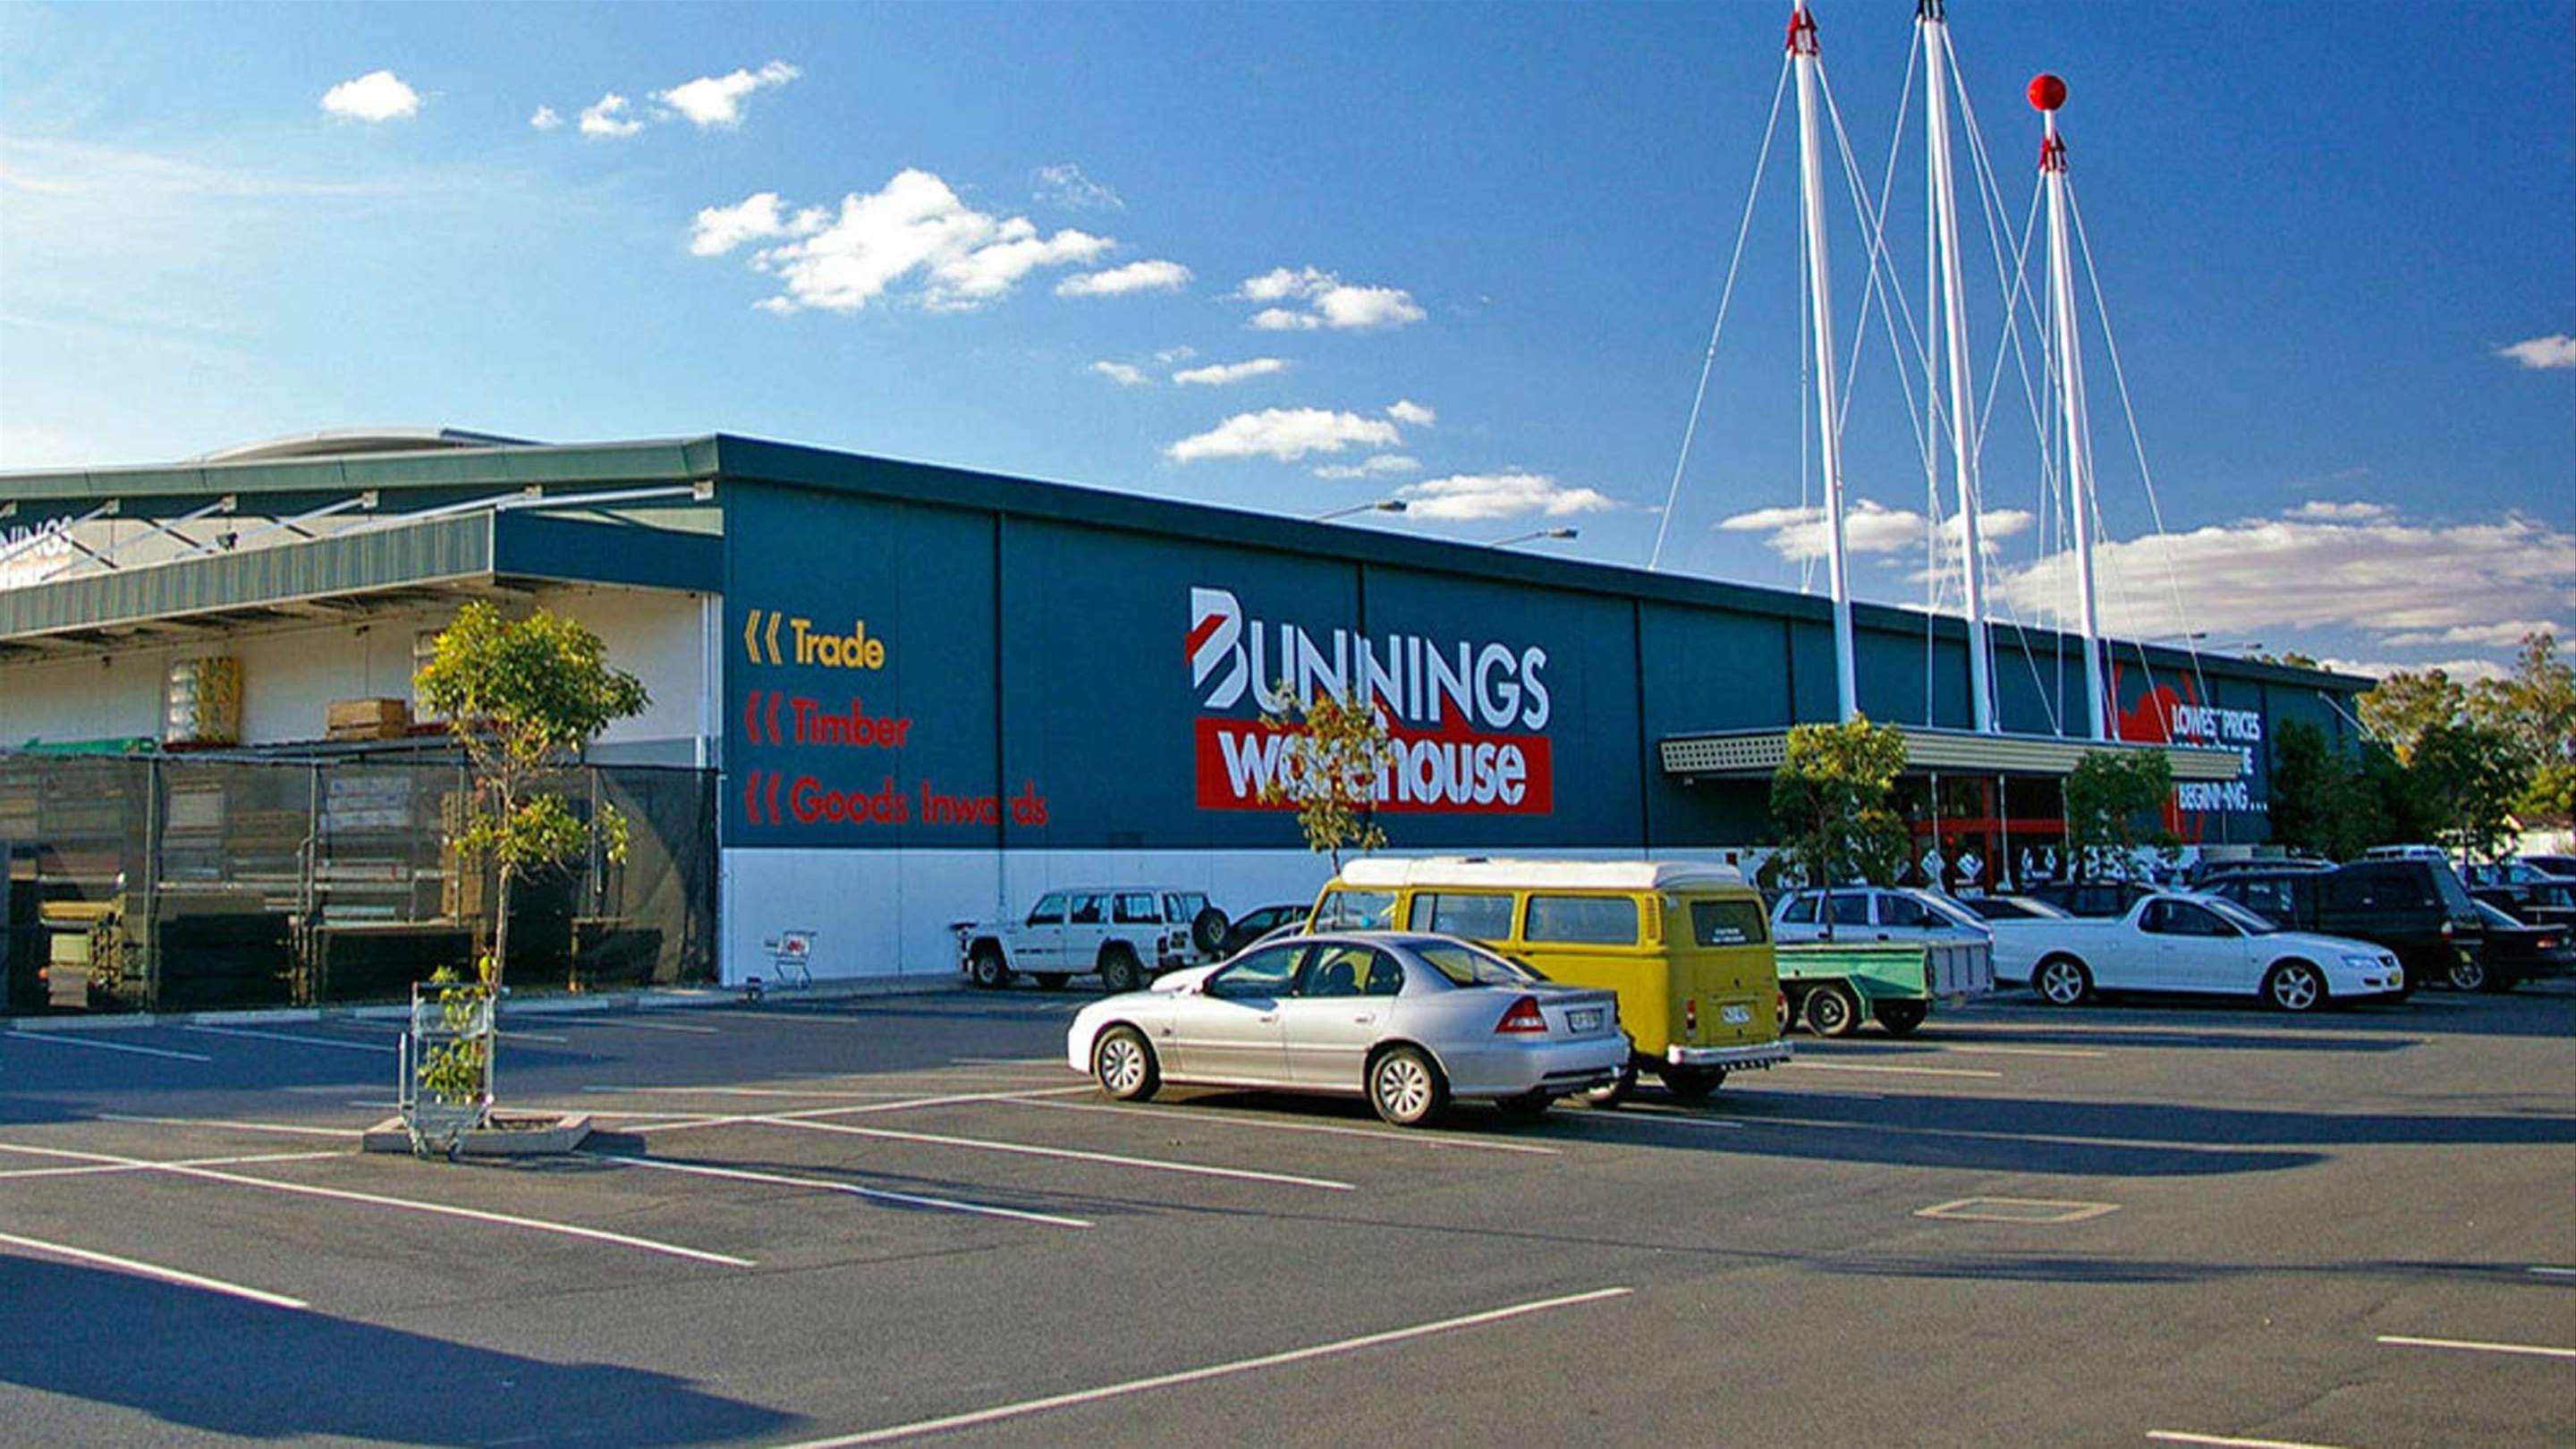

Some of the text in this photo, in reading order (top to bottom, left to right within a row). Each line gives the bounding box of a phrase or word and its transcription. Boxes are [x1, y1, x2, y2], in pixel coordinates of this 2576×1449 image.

[791, 617, 885, 669] Trade
[1185, 587, 1550, 730] BUNNINGS
[790, 697, 911, 748] Timber
[2223, 709, 2260, 741] PRICES
[790, 775, 1048, 825] Goods Inwads
